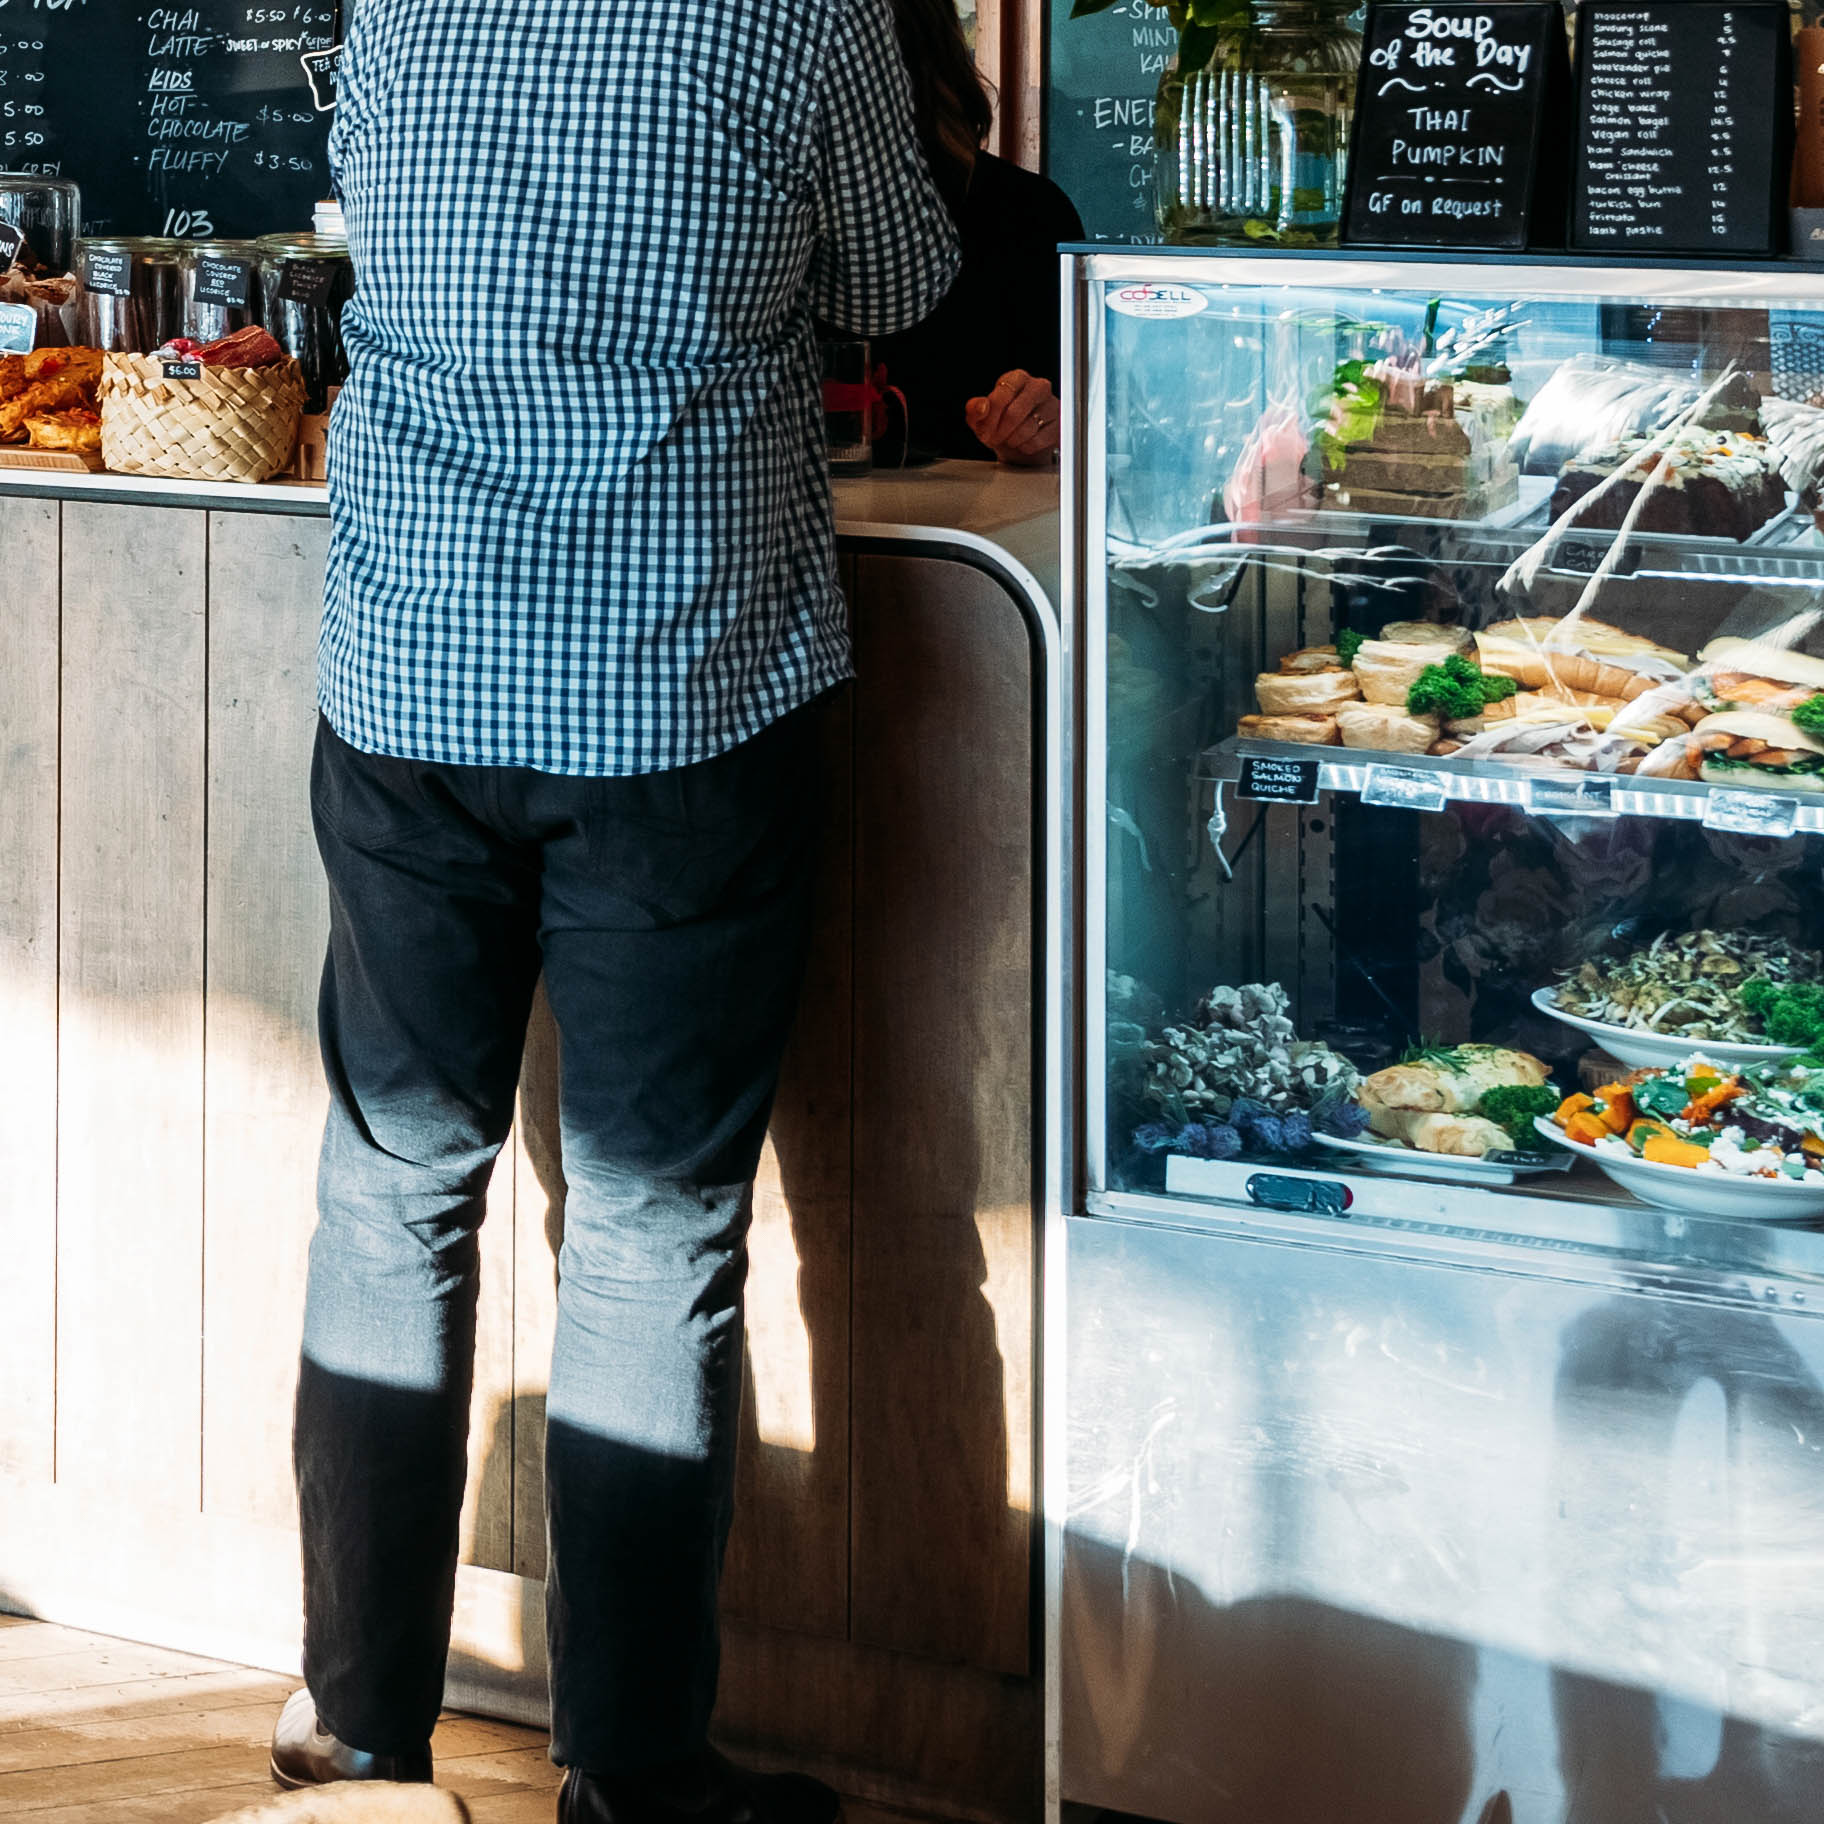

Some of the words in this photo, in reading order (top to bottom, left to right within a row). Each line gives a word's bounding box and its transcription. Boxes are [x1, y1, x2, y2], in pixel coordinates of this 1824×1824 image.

[148, 9, 199, 31] CHAI
[1405, 8, 1493, 42] Soup
[149, 36, 213, 57] LATTE
[1370, 39, 1401, 69] of
[1410, 39, 1455, 66] the
[1477, 38, 1531, 73] Day
[150, 68, 192, 89] KIDS
[1407, 106, 1471, 132] THAI
[148, 122, 250, 143] CHOCOLATE
[148, 151, 229, 173] FLUFFY
[1392, 140, 1504, 166] PUMPKIN
[1402, 199, 1422, 214] on
[1432, 196, 1503, 219] Request
[164, 208, 214, 237] 103
[1251, 782, 1297, 795] QUICHE
